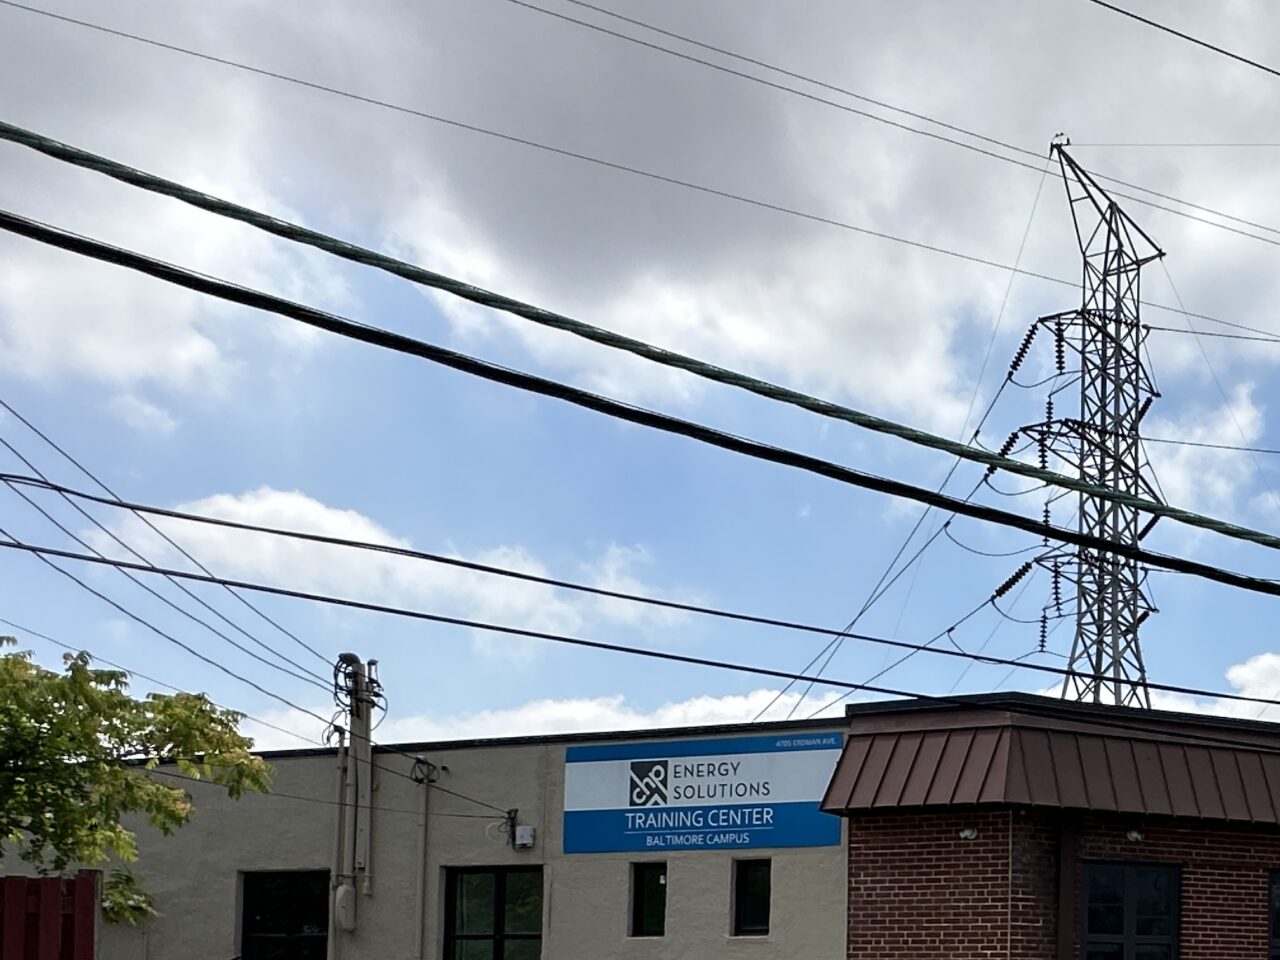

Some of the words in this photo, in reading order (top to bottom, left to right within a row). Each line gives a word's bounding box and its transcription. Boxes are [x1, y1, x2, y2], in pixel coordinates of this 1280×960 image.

[673, 762, 741, 779] ENERGY
[673, 781, 770, 800] SOLUTIONS
[625, 810, 704, 829] TRAINING
[708, 807, 774, 827] CENTER
[646, 833, 705, 846] BALTIMORE
[706, 832, 750, 844] CAMPUS
